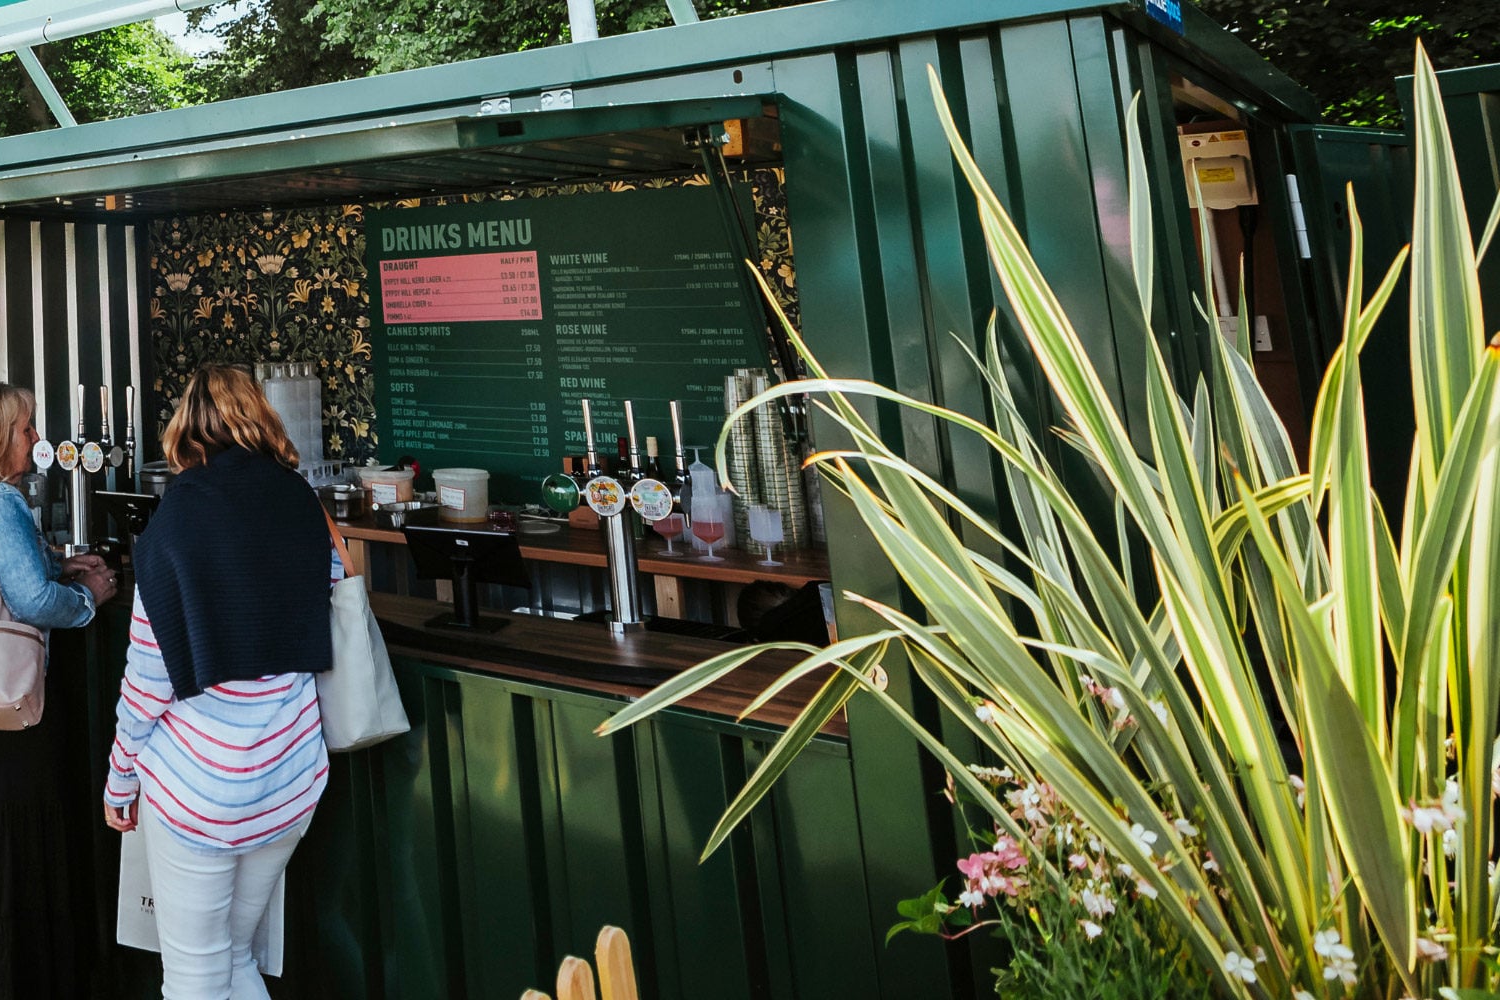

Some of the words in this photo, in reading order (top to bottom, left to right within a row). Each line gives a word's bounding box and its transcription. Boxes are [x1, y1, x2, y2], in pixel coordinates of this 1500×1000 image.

[382, 223, 461, 252] DRINKS
[467, 218, 532, 248] MENU
[383, 260, 418, 271] DRAUGHT
[500, 257, 514, 265] HALF
[520, 256, 533, 264] PINT
[550, 254, 580, 265] WHITE
[581, 253, 608, 264] WINE
[387, 326, 418, 336] CANNED
[419, 326, 451, 336] SPIRITS
[556, 324, 580, 335] ROSE
[581, 324, 608, 335] WINE
[526, 344, 540, 352] £7.50
[526, 358, 542, 366] £7.50
[528, 371, 543, 379] £7.50
[390, 383, 415, 392] SOFTS
[560, 377, 578, 388] RED
[580, 378, 606, 388] WINE
[392, 418, 412, 427] SQUARE
[412, 419, 425, 428] ROOT
[426, 420, 453, 430] LEMONADE
[532, 426, 548, 434] £3.50
[405, 430, 421, 438] APPLE
[422, 430, 436, 439] JUICE
[564, 430, 618, 443] SPARLING
[394, 440, 404, 448] LIFE
[405, 440, 422, 448] WATER
